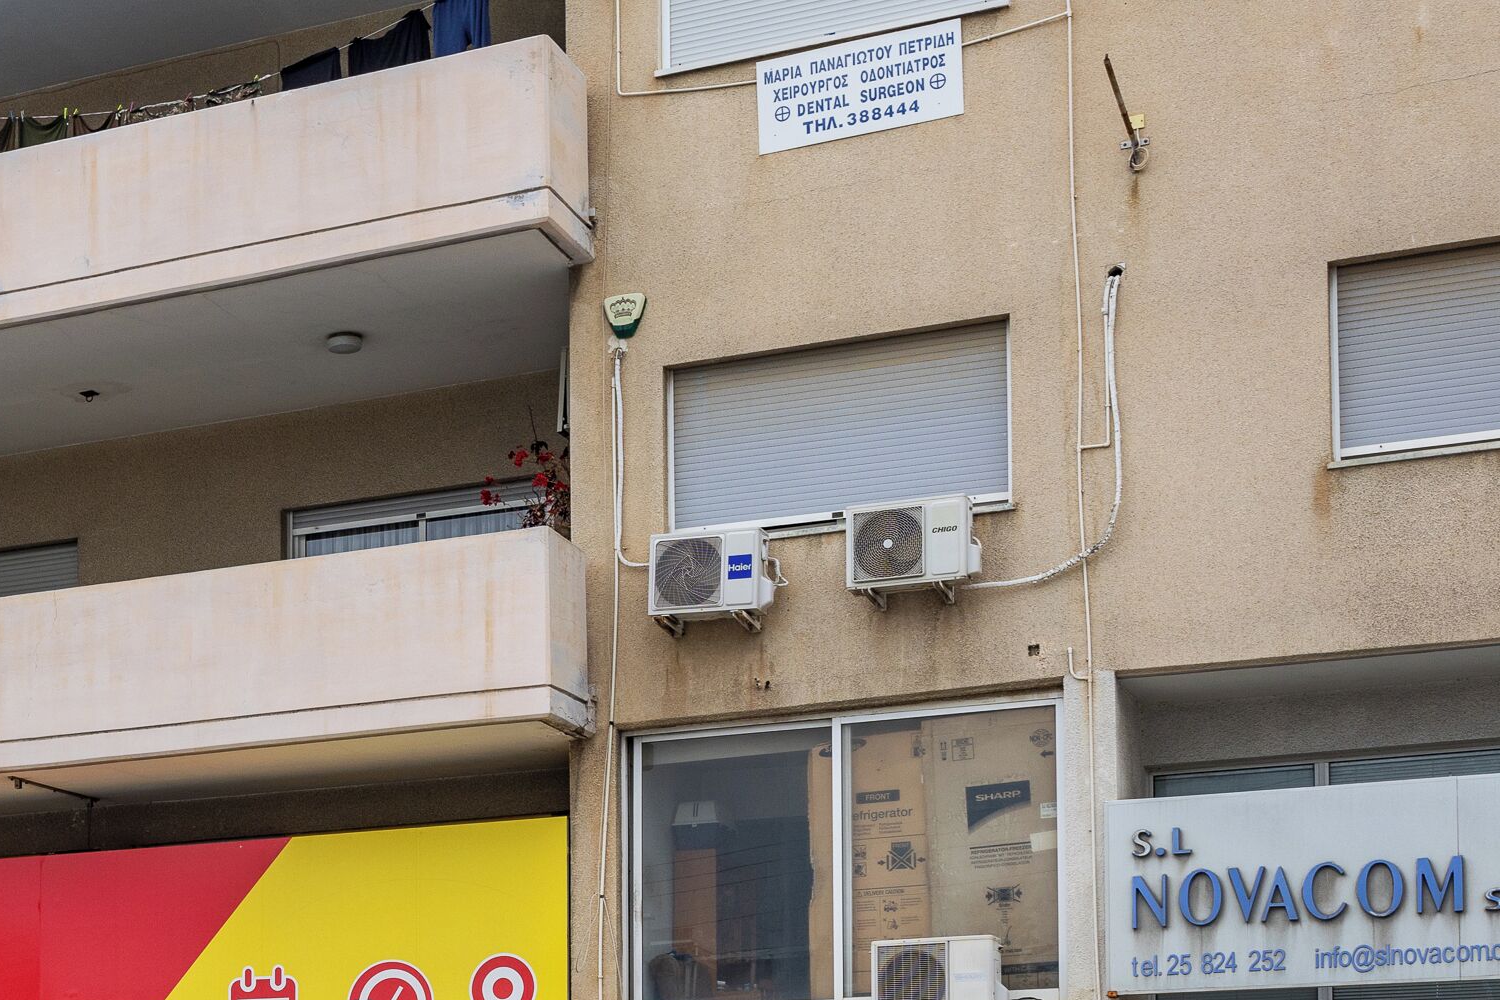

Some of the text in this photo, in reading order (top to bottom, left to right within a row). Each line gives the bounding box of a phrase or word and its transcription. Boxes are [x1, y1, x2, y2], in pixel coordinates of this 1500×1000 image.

[764, 32, 955, 85] ΜΑΡΙΑ ΠΑΝΑΓΙΩΤΟΥ ΠΕΤΡΙΔΗ
[773, 54, 946, 102] ΧΕΙΡΟΥΡΓΟΣ ΟΔΟΝΤΙΑΤΡΟΣ
[797, 78, 925, 117] DENTAL SURGEON
[931, 525, 958, 533] CHIGO
[728, 562, 752, 572] Haier
[865, 792, 891, 801] FRONT
[975, 790, 1021, 802] SHARP
[852, 807, 913, 821] efrigerator
[1131, 855, 1465, 930] NOVACOM
[1201, 951, 1237, 975] 824
[1248, 949, 1287, 973] 252
